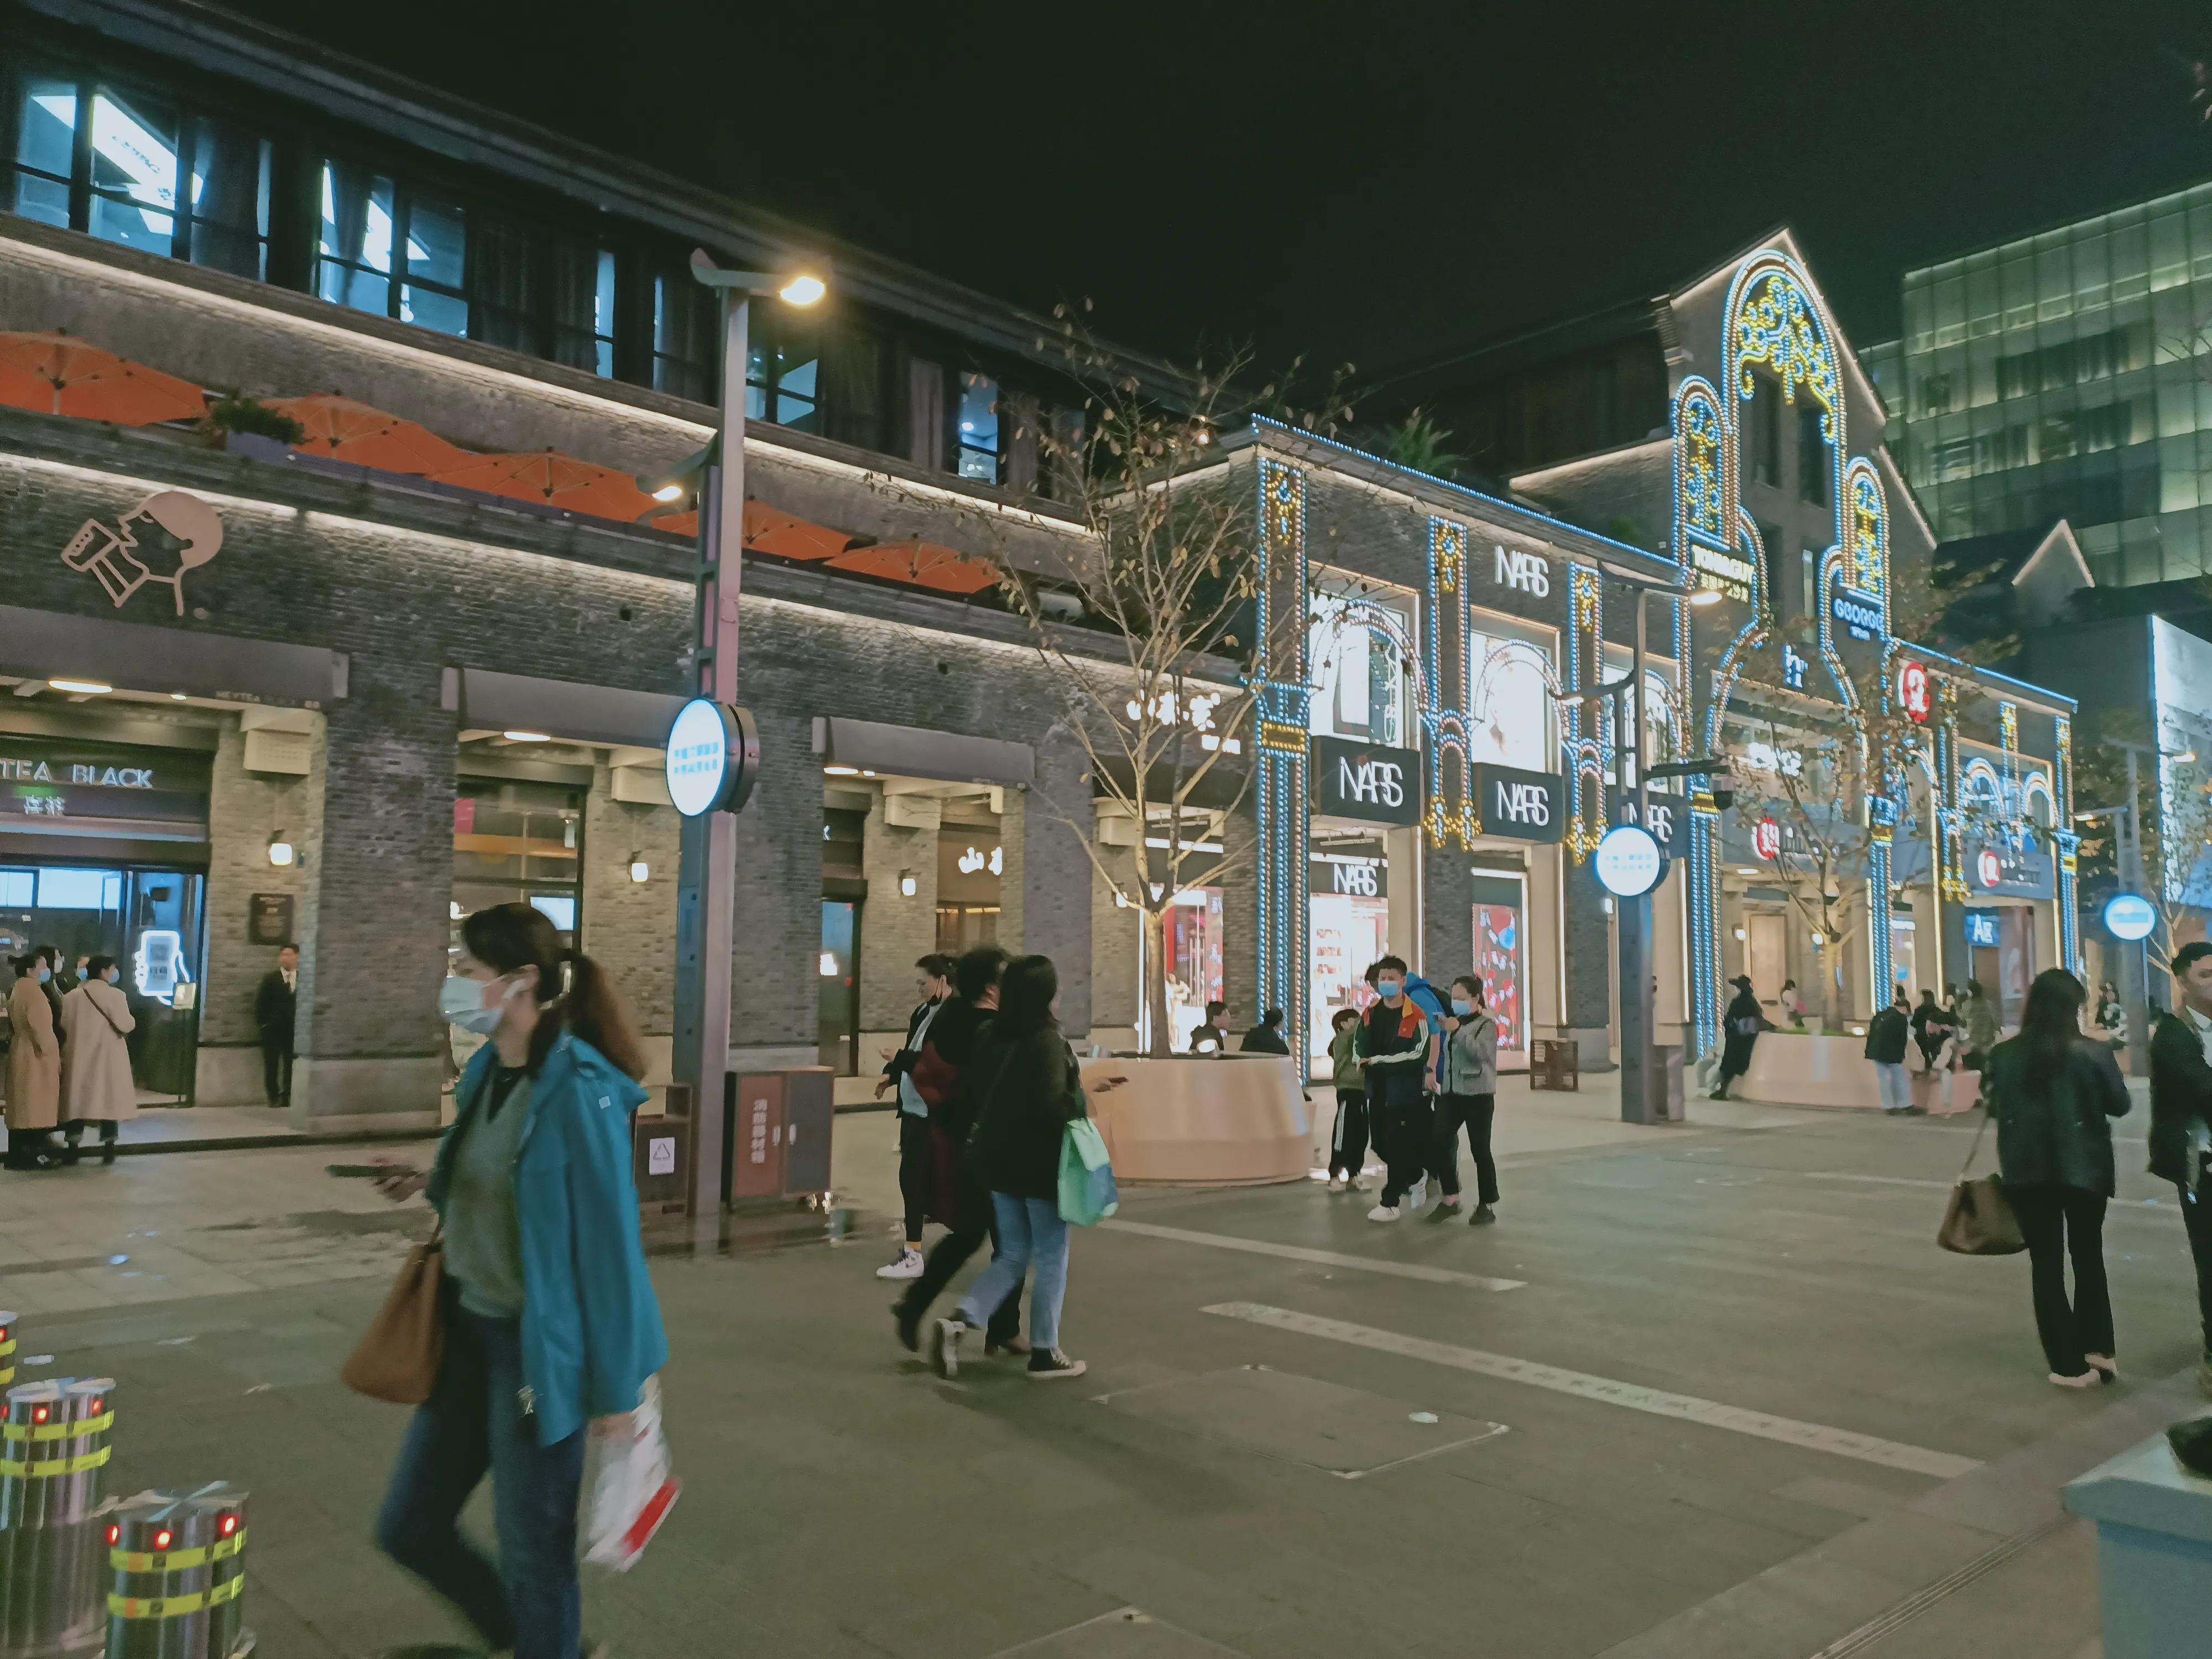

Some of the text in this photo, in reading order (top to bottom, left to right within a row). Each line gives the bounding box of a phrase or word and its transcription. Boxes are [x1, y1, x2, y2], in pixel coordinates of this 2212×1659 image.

[1494, 545, 1549, 598] NARS
[72, 763, 153, 789] BLACK
[1339, 756, 1404, 807] NARS
[1495, 780, 1549, 826] NARS
[1333, 863, 1378, 896] NARS
